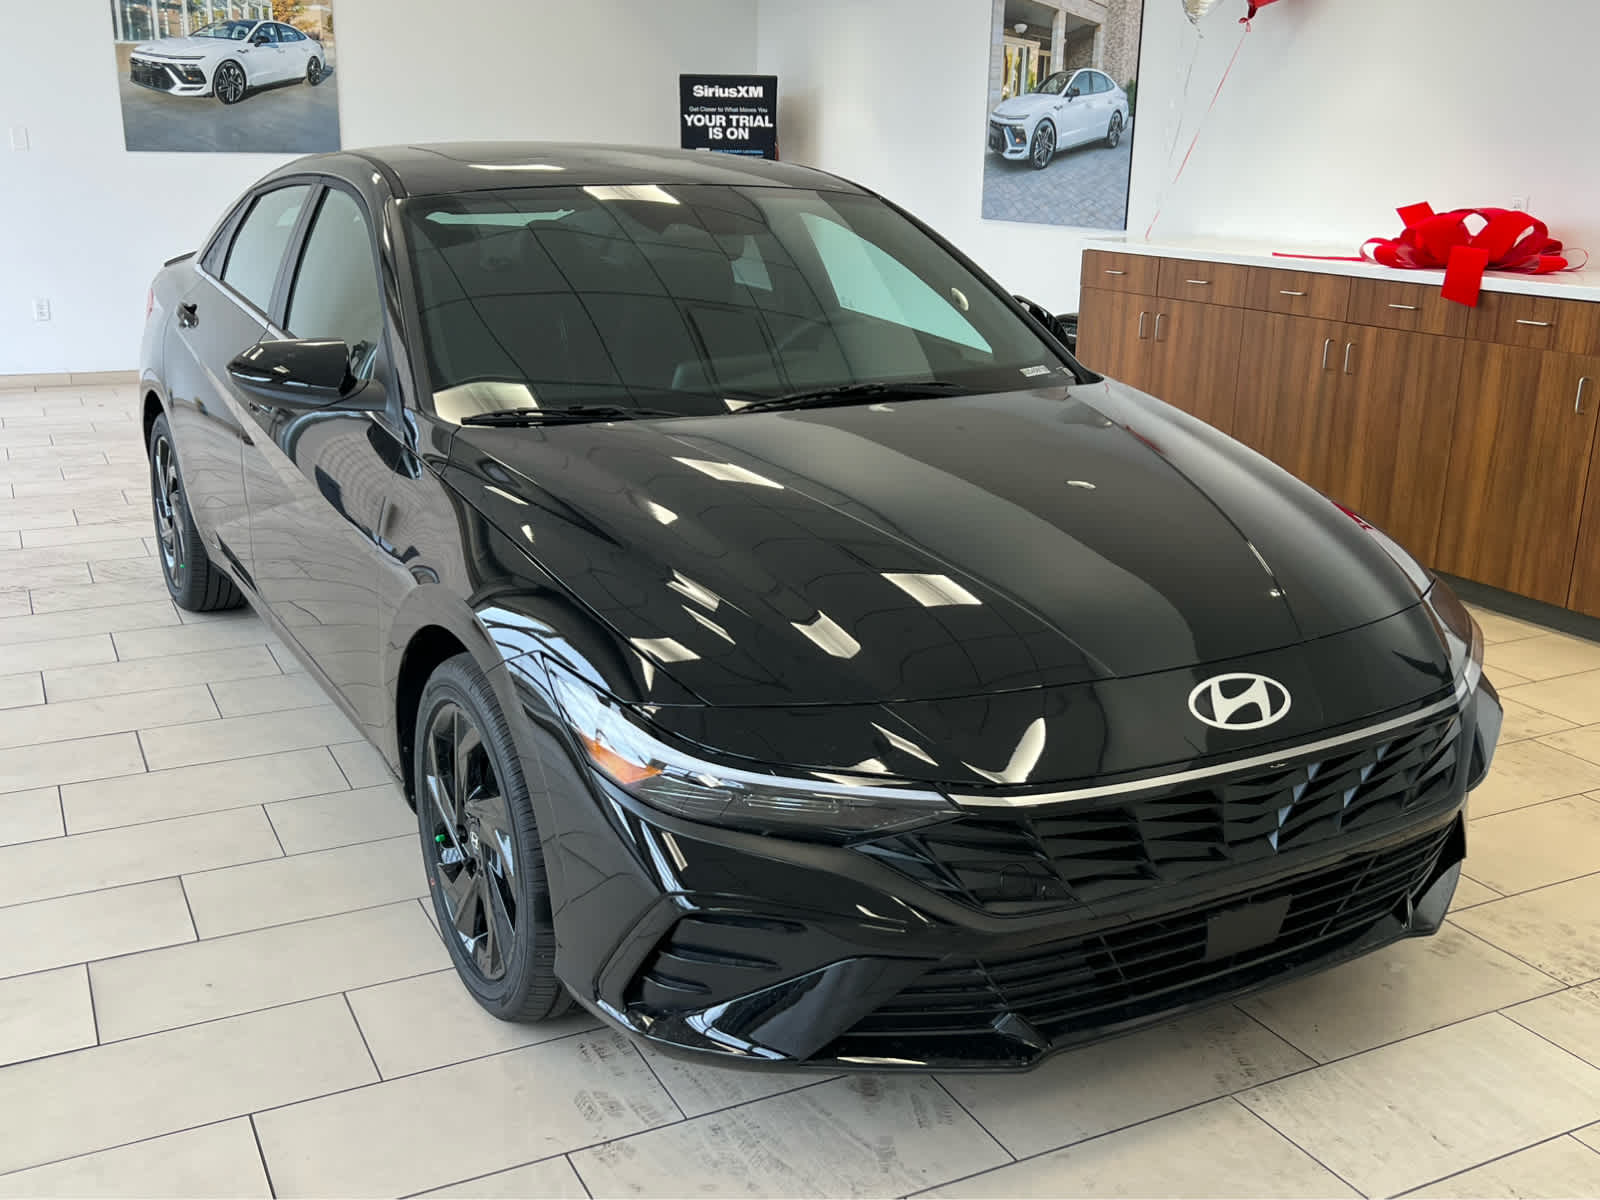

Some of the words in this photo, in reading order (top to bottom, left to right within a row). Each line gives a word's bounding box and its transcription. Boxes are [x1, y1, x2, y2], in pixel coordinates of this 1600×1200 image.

[692, 85, 764, 98] SiriusXM
[684, 114, 727, 127] YOUR
[729, 115, 774, 127] TRIAL
[708, 127, 723, 139] IS
[726, 127, 749, 140] ON
